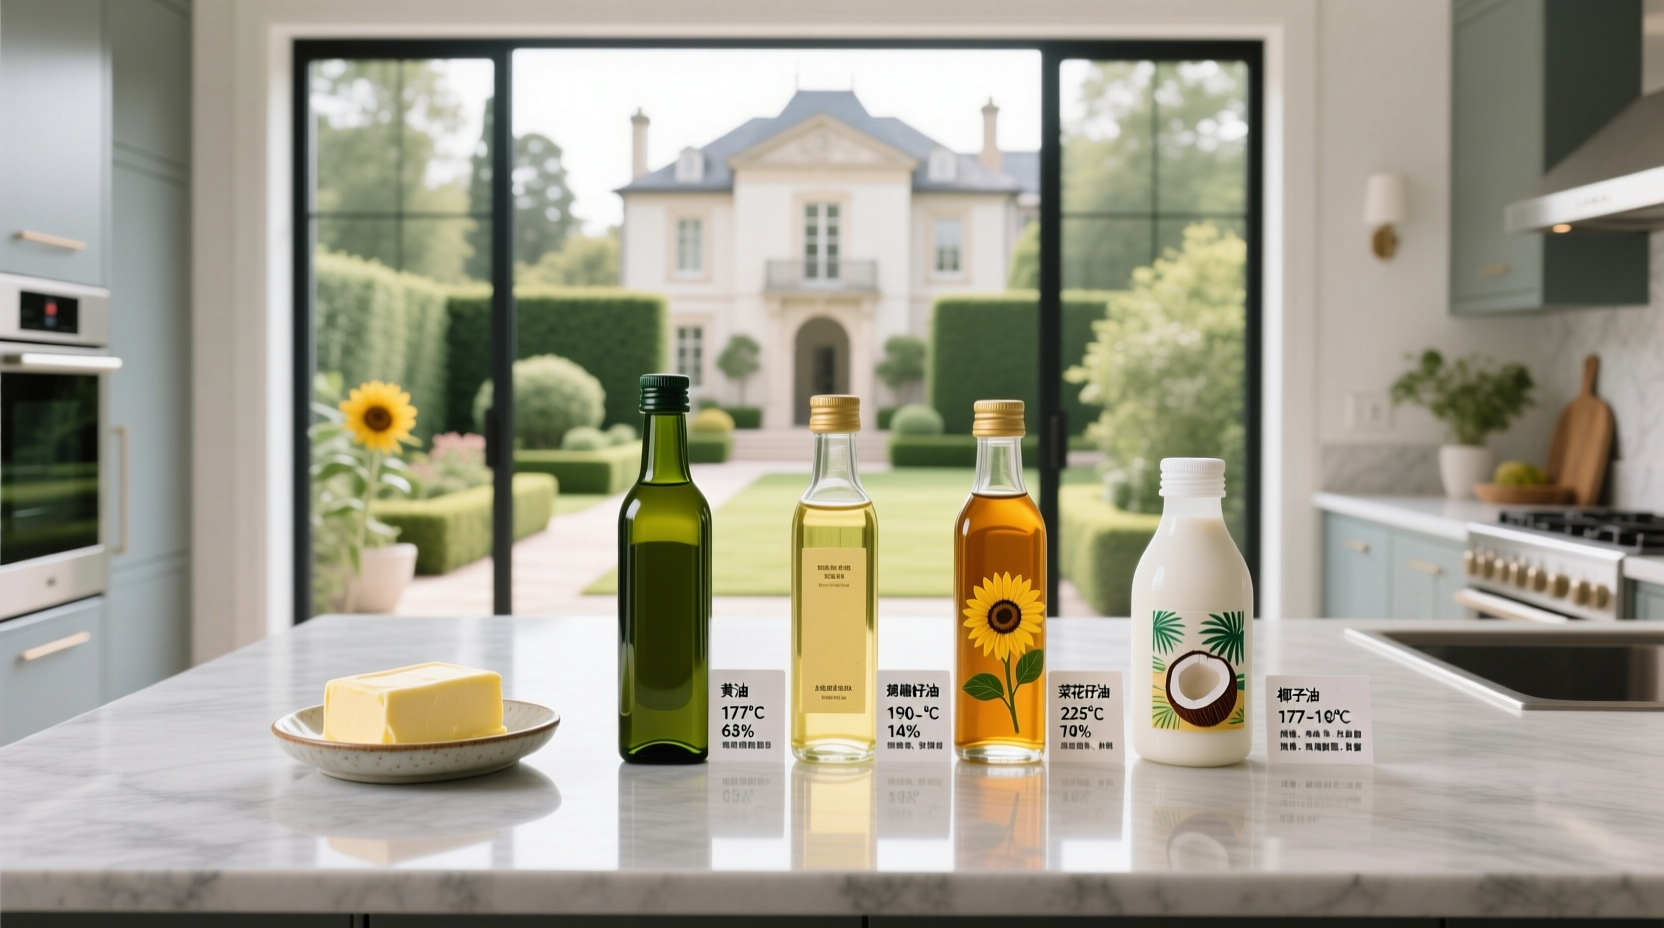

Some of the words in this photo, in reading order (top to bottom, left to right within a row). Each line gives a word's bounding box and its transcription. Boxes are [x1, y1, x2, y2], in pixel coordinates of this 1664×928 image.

[720, 682, 749, 698] 黄油
[1276, 686, 1320, 704] 椰子油
[721, 704, 765, 720] 177°C
[1060, 704, 1105, 721] 225°C
[887, 723, 921, 738] 14%
[1059, 724, 1092, 738] 70%
